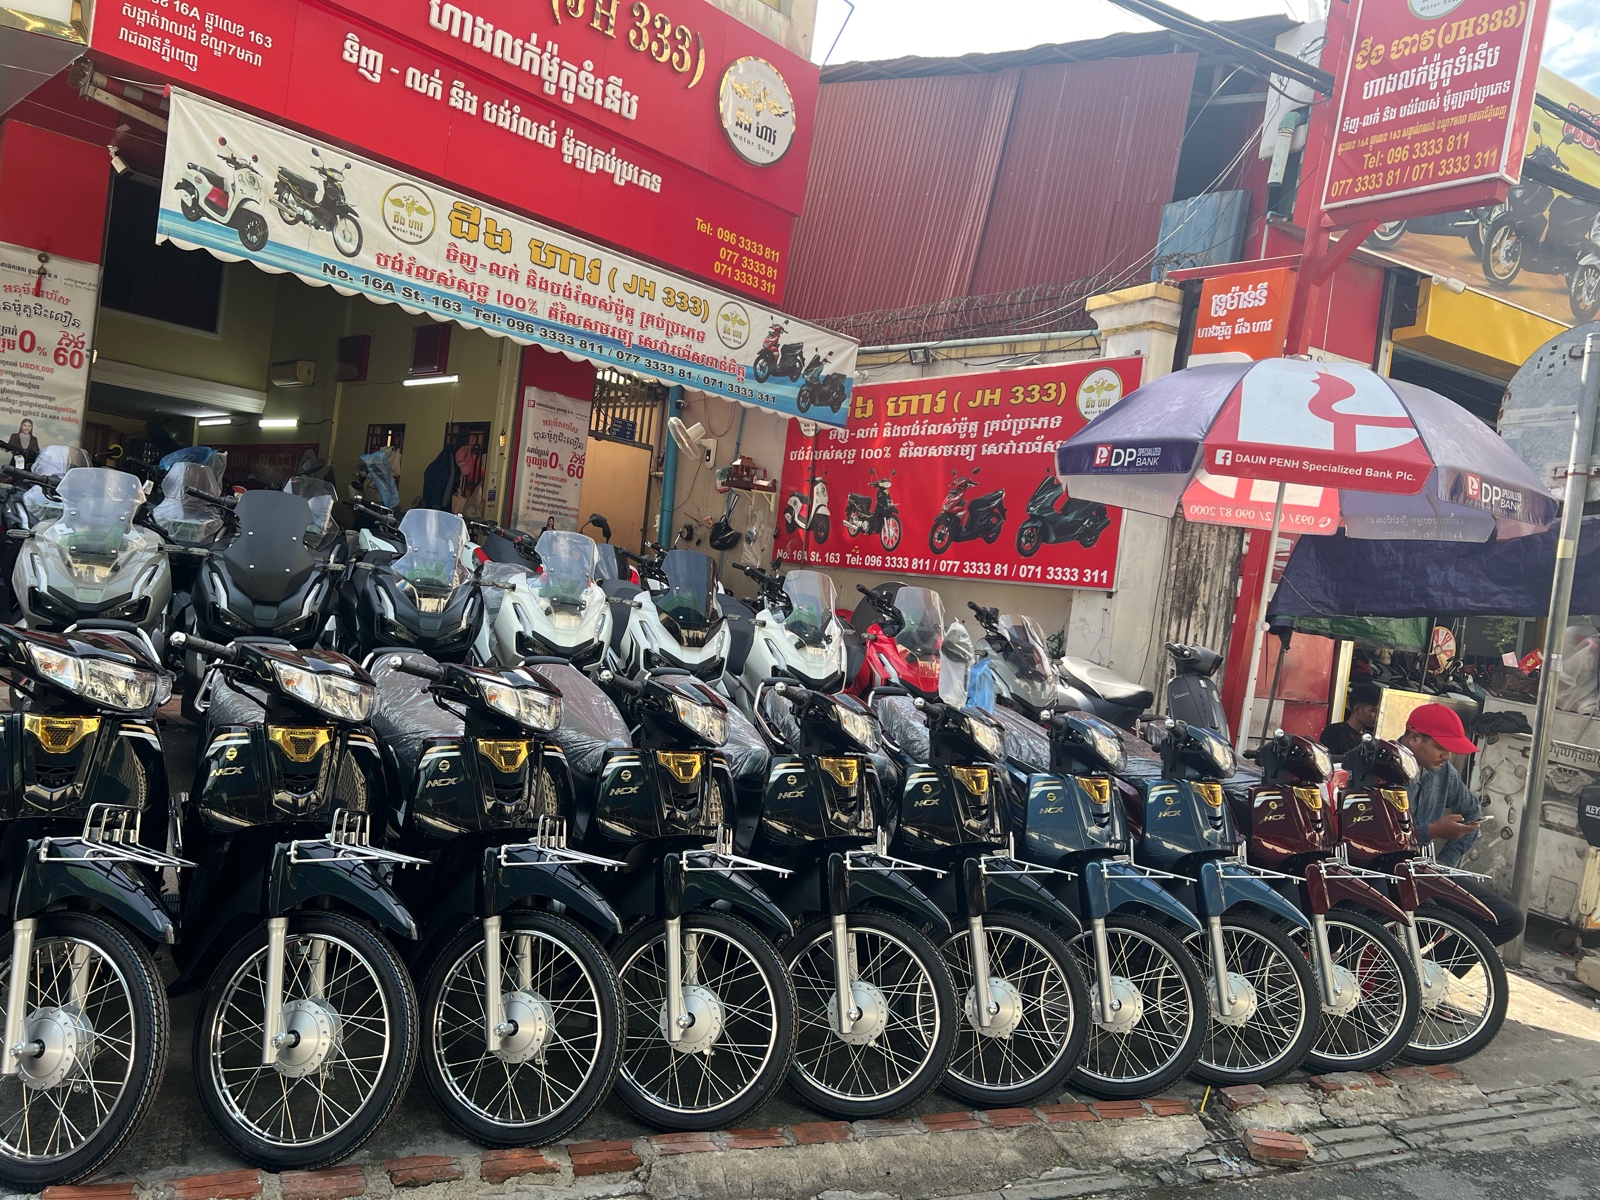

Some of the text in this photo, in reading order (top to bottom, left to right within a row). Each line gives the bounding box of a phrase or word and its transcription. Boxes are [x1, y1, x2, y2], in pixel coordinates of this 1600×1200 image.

[1419, 2, 1442, 12] Motor
[173, 0, 200, 21] 16A
[249, 30, 273, 49] 163
[629, 1, 706, 89] 333)
[343, 32, 383, 83] ទិញ
[405, 67, 443, 100] លក់
[733, 132, 775, 157] Motor Shop
[1356, 130, 1401, 148] 16A 163
[1363, 131, 1470, 170] Tel: 096 3333 811
[1331, 148, 1498, 198] 077 3333 81 / 071 3333 311
[391, 225, 423, 241] Motor Shop
[695, 217, 780, 263] Tel: 096 3333 811
[714, 260, 776, 295] 071 3333 311
[719, 247, 778, 281] 077 3333 81
[528, 238, 602, 285] ហាវ
[662, 286, 710, 323] 333)
[496, 289, 539, 315] 100%
[322, 262, 777, 405] No. 16A St. 163 Tel: 096 3333 811 / 077 3333 81 / 071 3333 311
[19, 361, 54, 374] USD5,000
[53, 347, 84, 369] 60
[886, 389, 947, 418] ហាវ
[1009, 381, 1068, 406] 333)
[861, 447, 892, 460] 100%
[1110, 448, 1138, 467] DP
[1135, 457, 1160, 467] BANK
[567, 463, 584, 479] 60
[1235, 453, 1417, 482] DAUN PENH Specialized Bank Plc.
[1482, 482, 1501, 506] DP
[1500, 499, 1522, 511] BANK
[777, 549, 790, 561] No.
[810, 552, 822, 563] St.
[824, 553, 841, 564] 163
[845, 554, 862, 566] Tel:
[864, 555, 882, 567] 096
[884, 556, 909, 569] 3333
[911, 558, 930, 571] 811
[932, 559, 938, 572] /
[939, 560, 960, 573] 077
[962, 561, 991, 575] 3333
[993, 563, 1008, 577] 81
[1011, 564, 1017, 577] /
[1019, 565, 1042, 579] 071
[1046, 566, 1079, 581] 3333
[1082, 569, 1108, 584] 311
